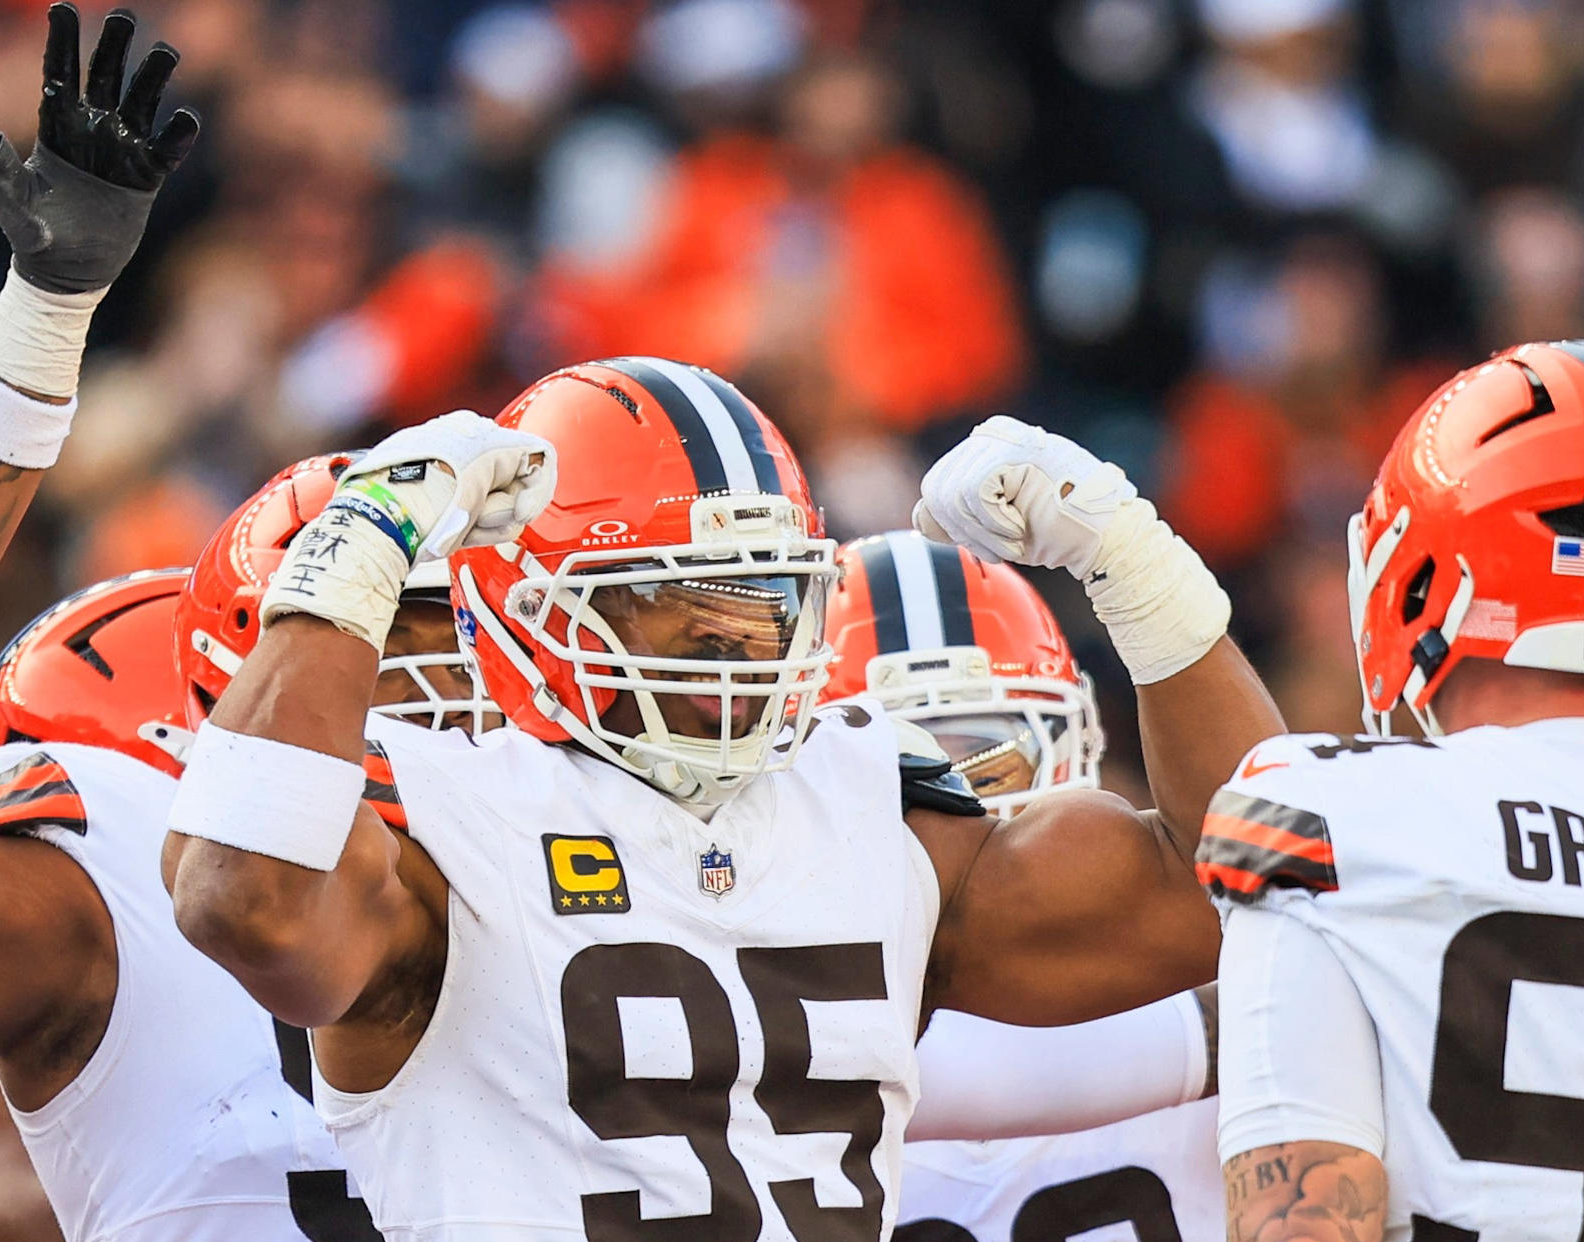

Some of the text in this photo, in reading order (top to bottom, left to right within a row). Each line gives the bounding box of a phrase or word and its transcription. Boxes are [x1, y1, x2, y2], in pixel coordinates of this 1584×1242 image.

[581, 534, 640, 547] OAKLEY
[550, 838, 621, 893] C
[704, 868, 732, 891] NFL
[1256, 1154, 1293, 1190] BY
